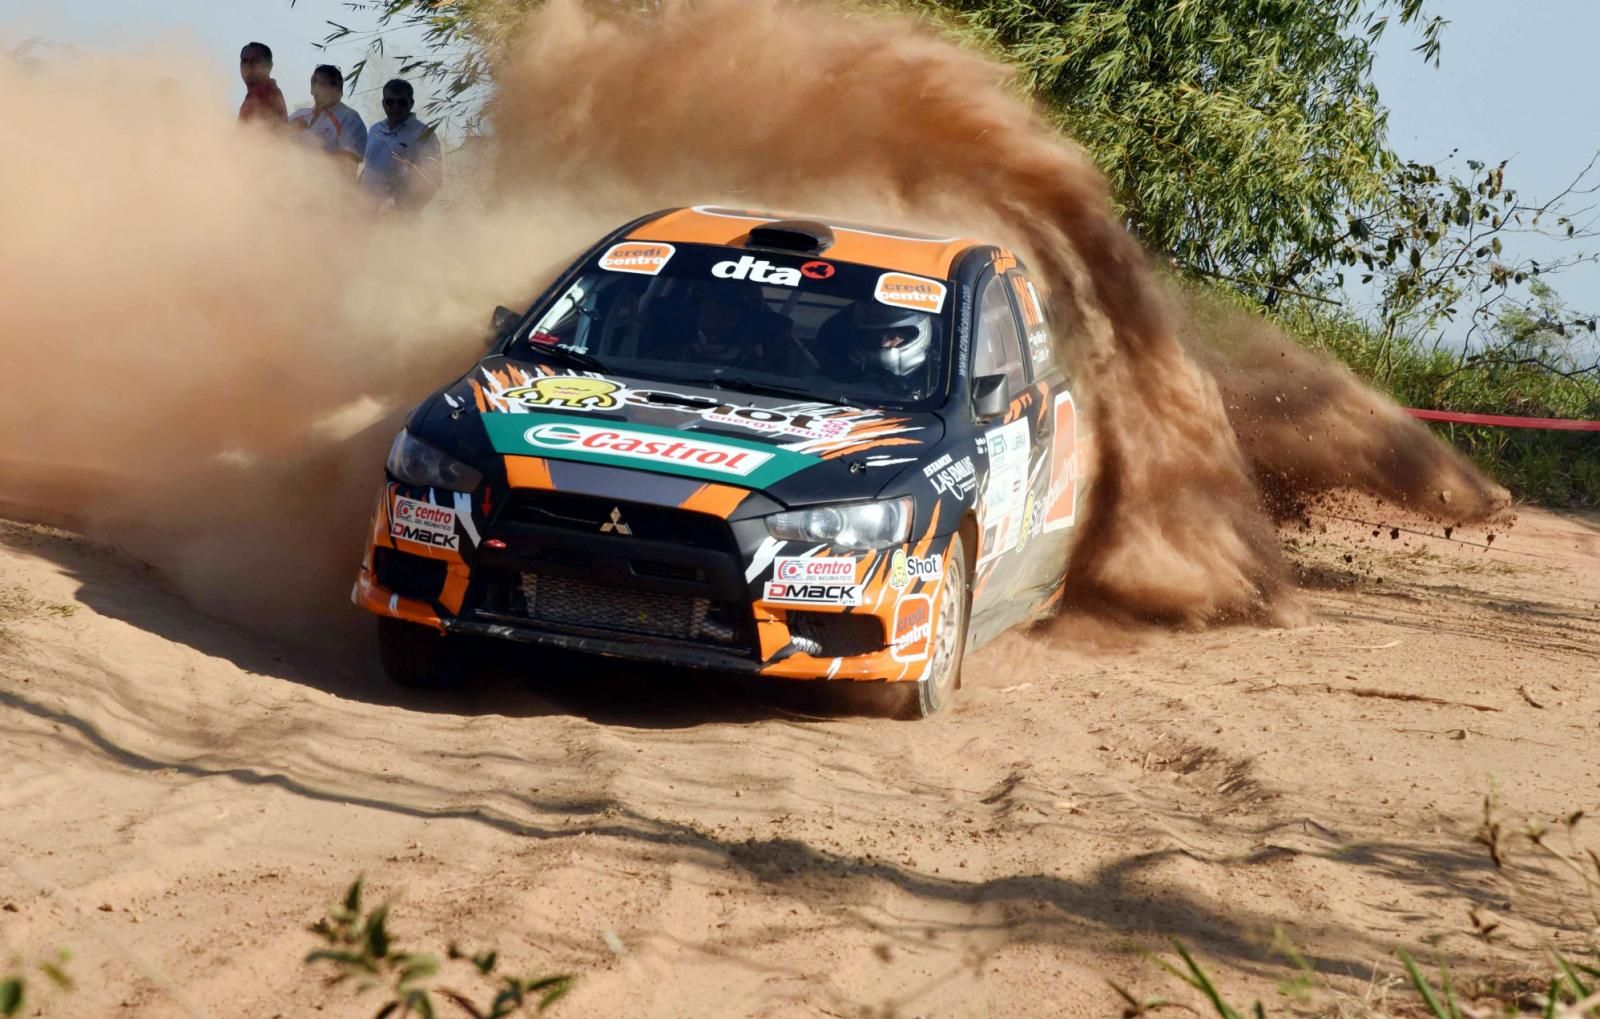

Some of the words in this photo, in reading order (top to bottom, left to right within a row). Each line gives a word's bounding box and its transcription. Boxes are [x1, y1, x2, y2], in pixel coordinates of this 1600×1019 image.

[605, 256, 665, 265] centro
[613, 248, 661, 257] credi
[711, 256, 802, 287] dta
[880, 291, 940, 302] centro
[884, 284, 931, 293] credi
[708, 414, 778, 430] energy
[582, 432, 749, 469] Castrol
[930, 470, 955, 495] LAS
[415, 506, 452, 525] centro
[806, 561, 852, 574] centro
[907, 558, 937, 576] Shot
